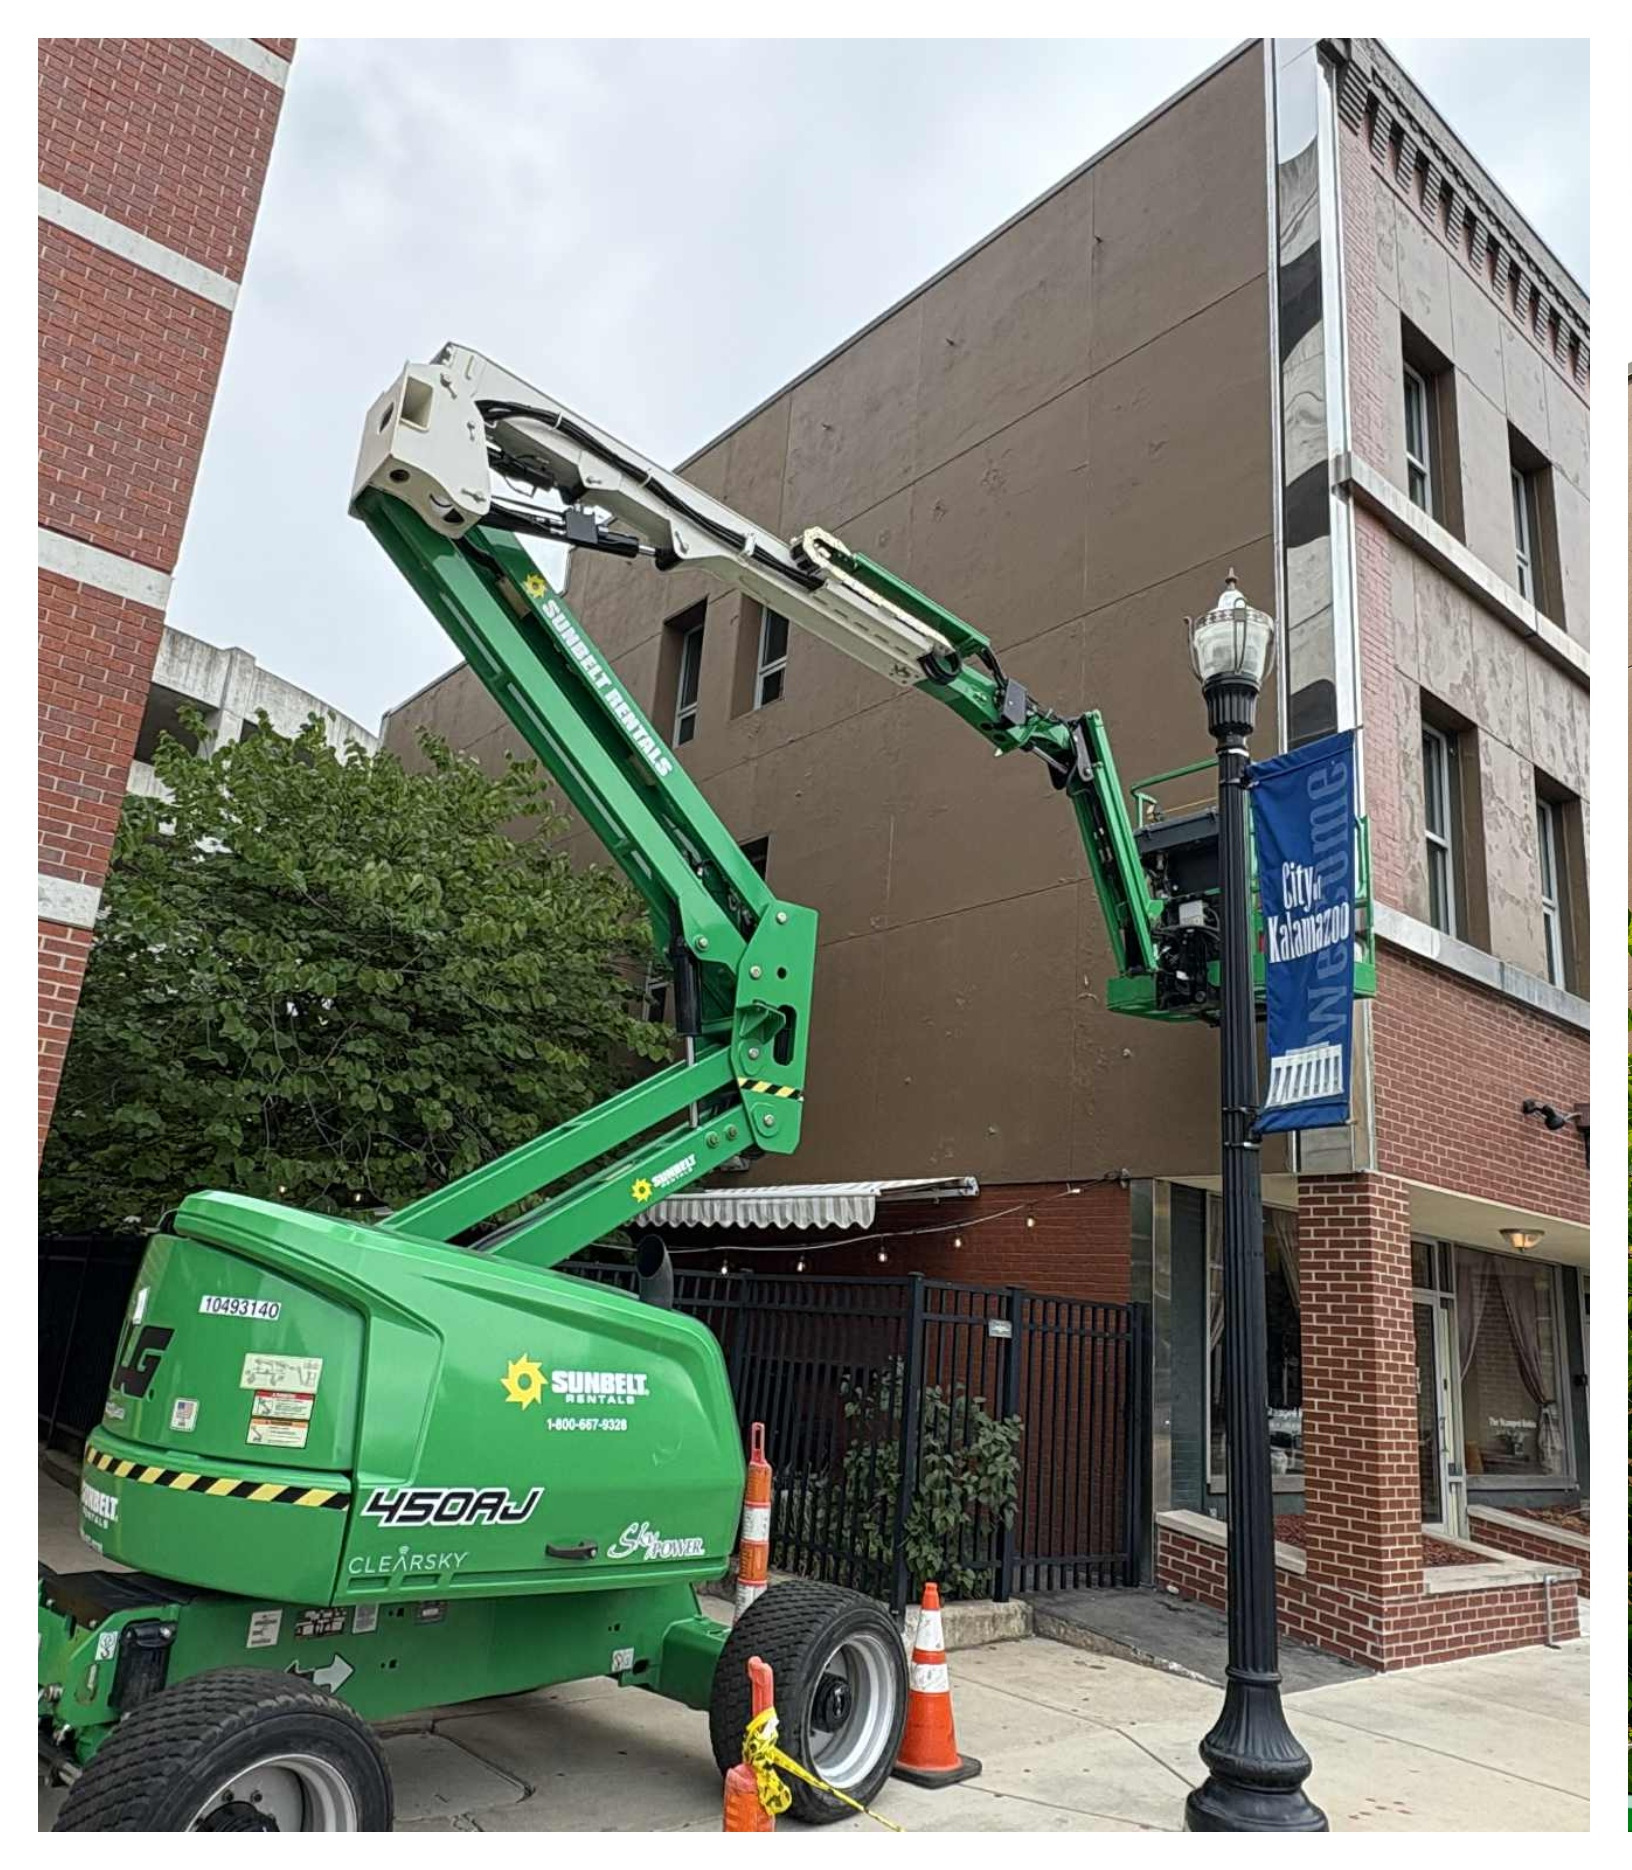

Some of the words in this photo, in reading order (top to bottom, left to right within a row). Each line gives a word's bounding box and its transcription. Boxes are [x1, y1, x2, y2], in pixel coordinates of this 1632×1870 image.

[543, 600, 612, 688] SUNBELT
[604, 688, 673, 776] RENTALS
[1282, 862, 1314, 912] City
[1268, 902, 1349, 963] Kalamazoo
[204, 1298, 279, 1319] 10493140
[551, 1370, 647, 1396] SUNBELT
[566, 1394, 635, 1404] RENTALS
[361, 1487, 545, 1527] 450AJ
[607, 1521, 660, 1560] Sky
[349, 1552, 468, 1574] CLEARSKY
